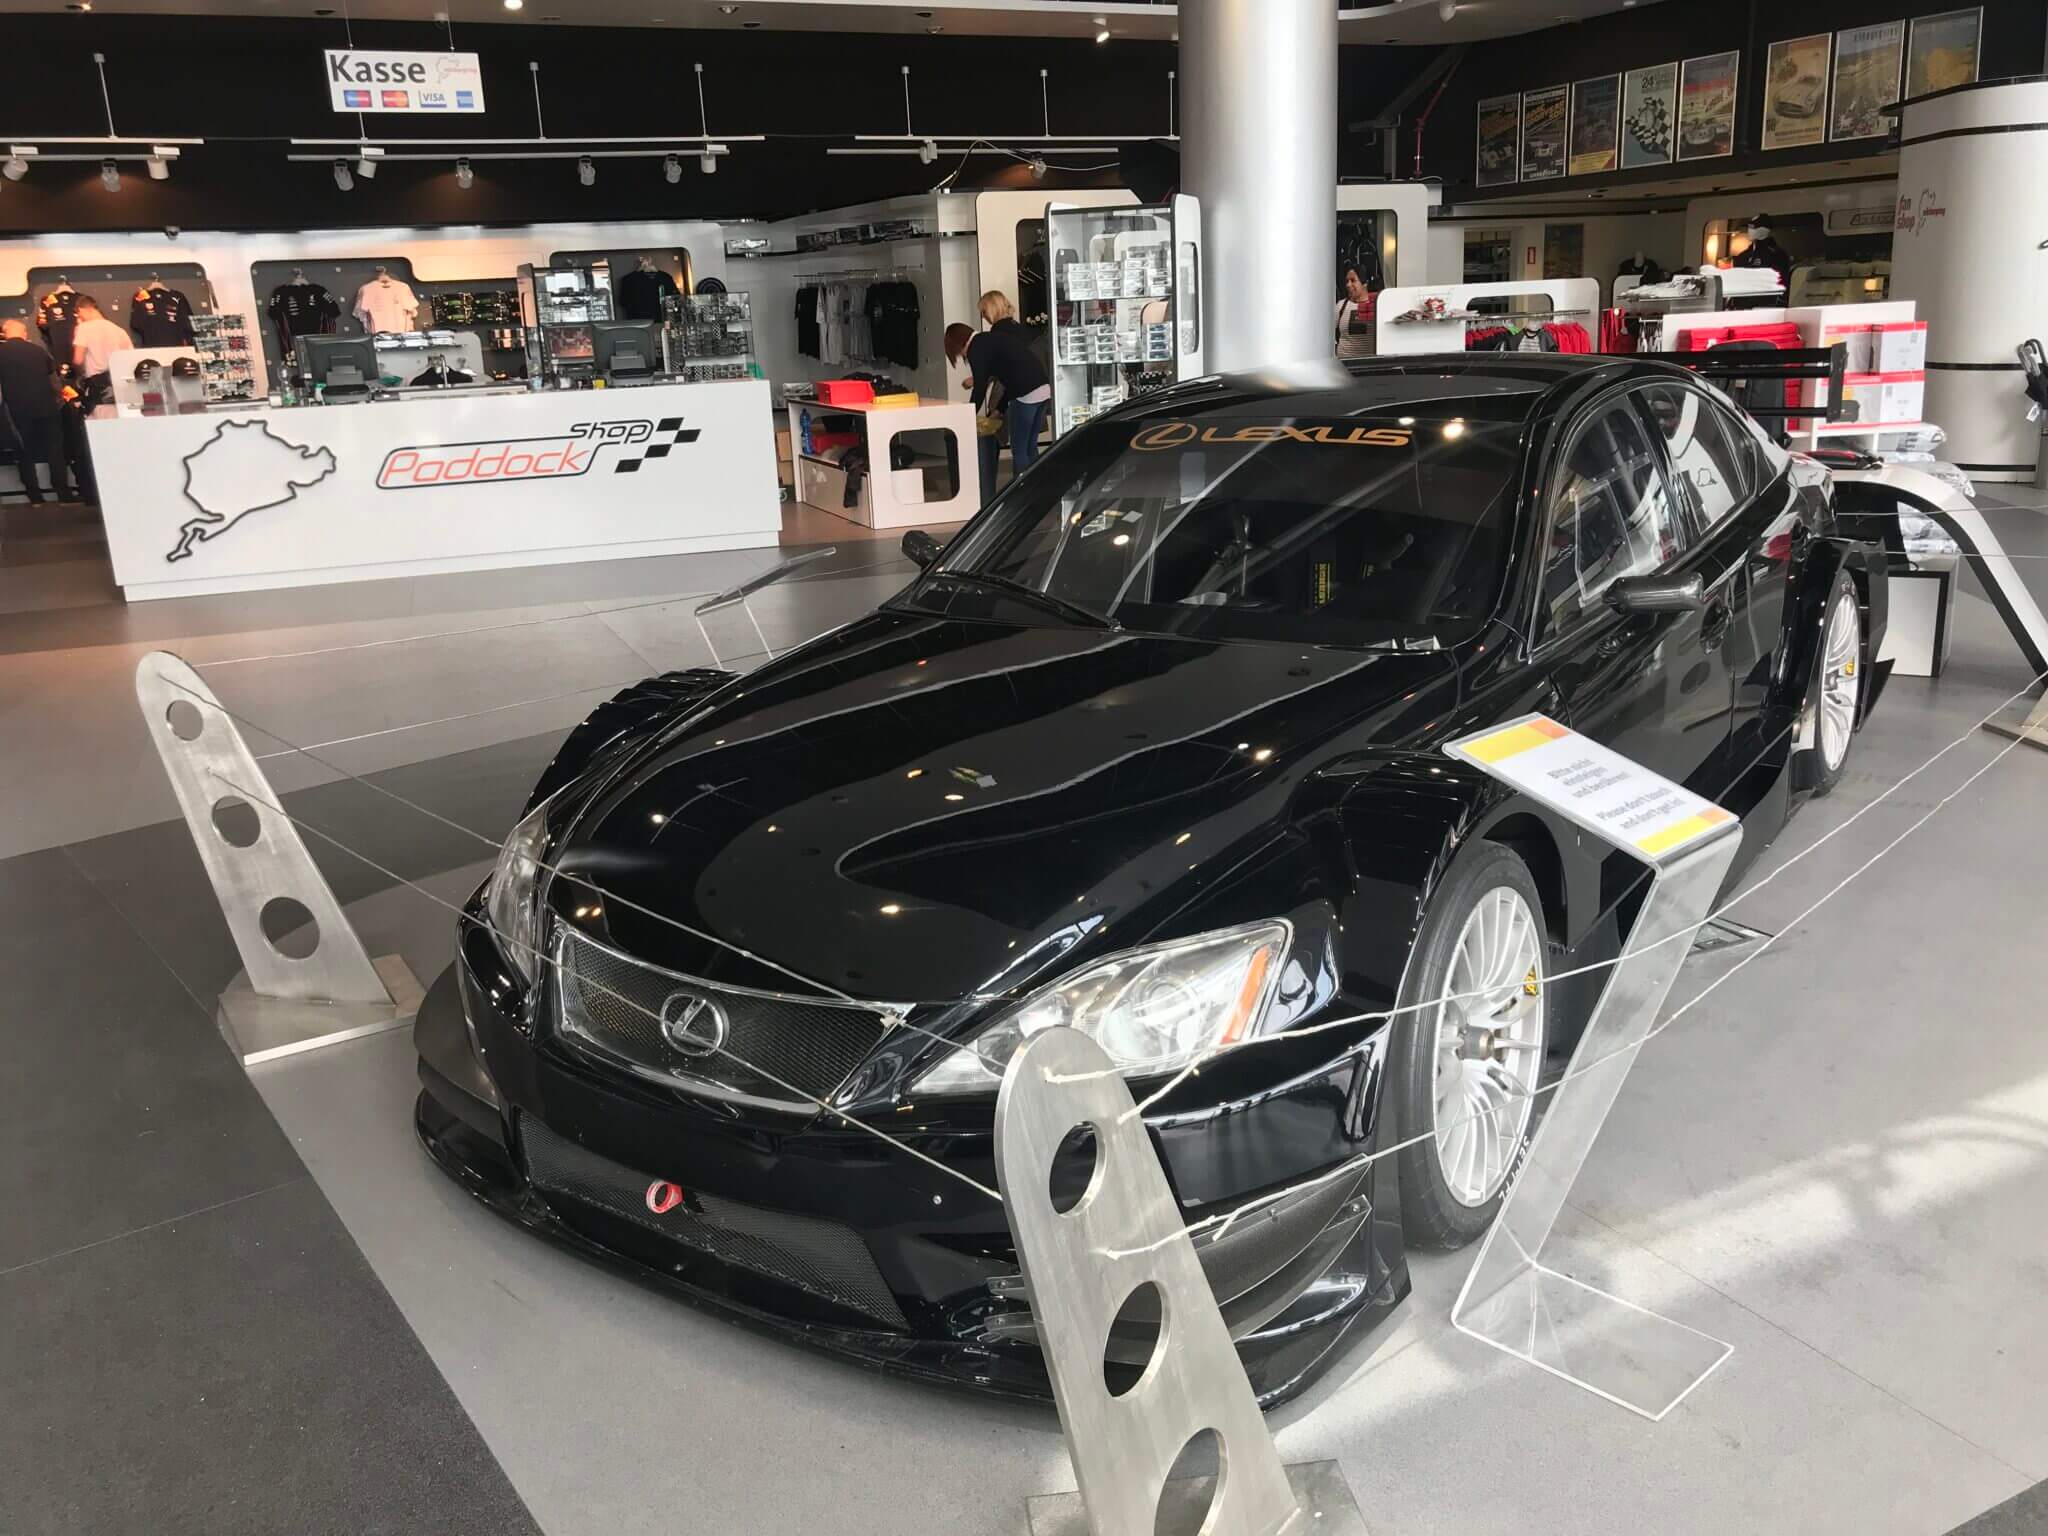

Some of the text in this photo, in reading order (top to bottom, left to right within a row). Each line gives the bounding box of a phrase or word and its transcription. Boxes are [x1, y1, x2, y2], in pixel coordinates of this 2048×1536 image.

[329, 54, 426, 83] Kasse
[422, 92, 445, 102] VISA
[1200, 426, 1413, 447] LEXUS
[382, 441, 591, 485] Paddock
